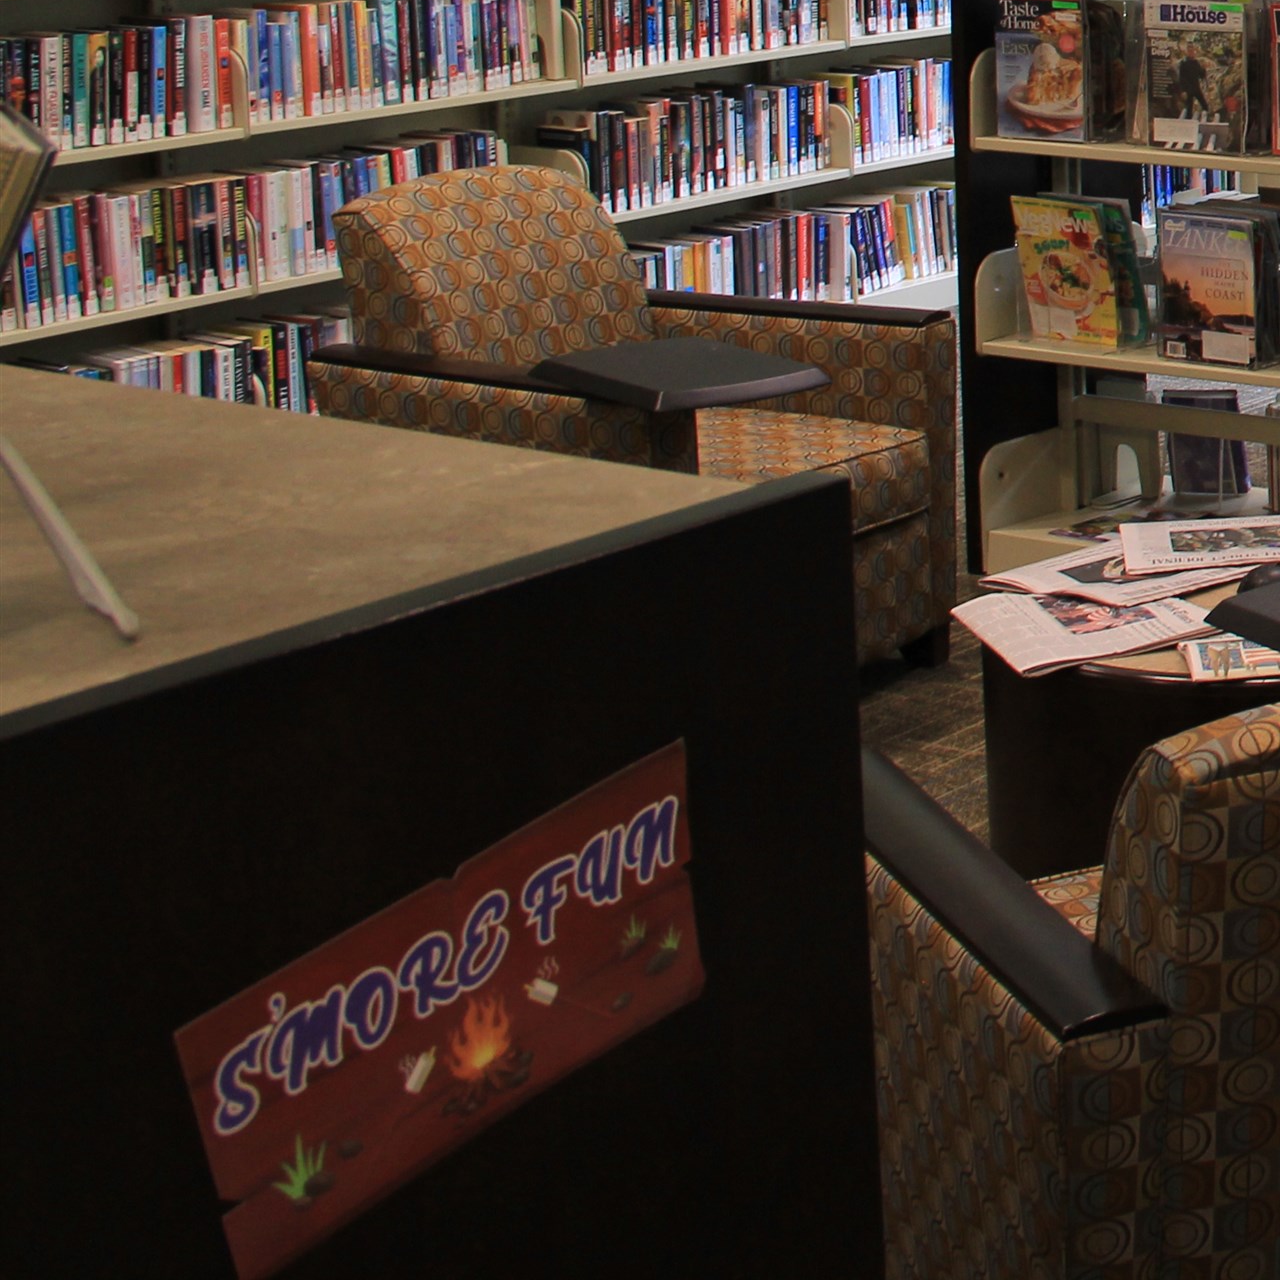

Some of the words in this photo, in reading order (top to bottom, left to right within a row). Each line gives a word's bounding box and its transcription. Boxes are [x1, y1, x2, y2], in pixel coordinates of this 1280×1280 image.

[1000, 0, 1039, 17] Taste
[1173, 5, 1227, 24] House
[1007, 17, 1040, 30] Home
[1001, 40, 1035, 56] Easy
[176, 51, 185, 87] JOHANSEN
[201, 49, 210, 88] JOHANSEN
[235, 202, 244, 240] KELLERMAN
[1200, 266, 1248, 280] HIDDEN
[1205, 288, 1244, 301] COAST
[213, 888, 510, 1136] S'MORE
[521, 794, 680, 946] FUN
